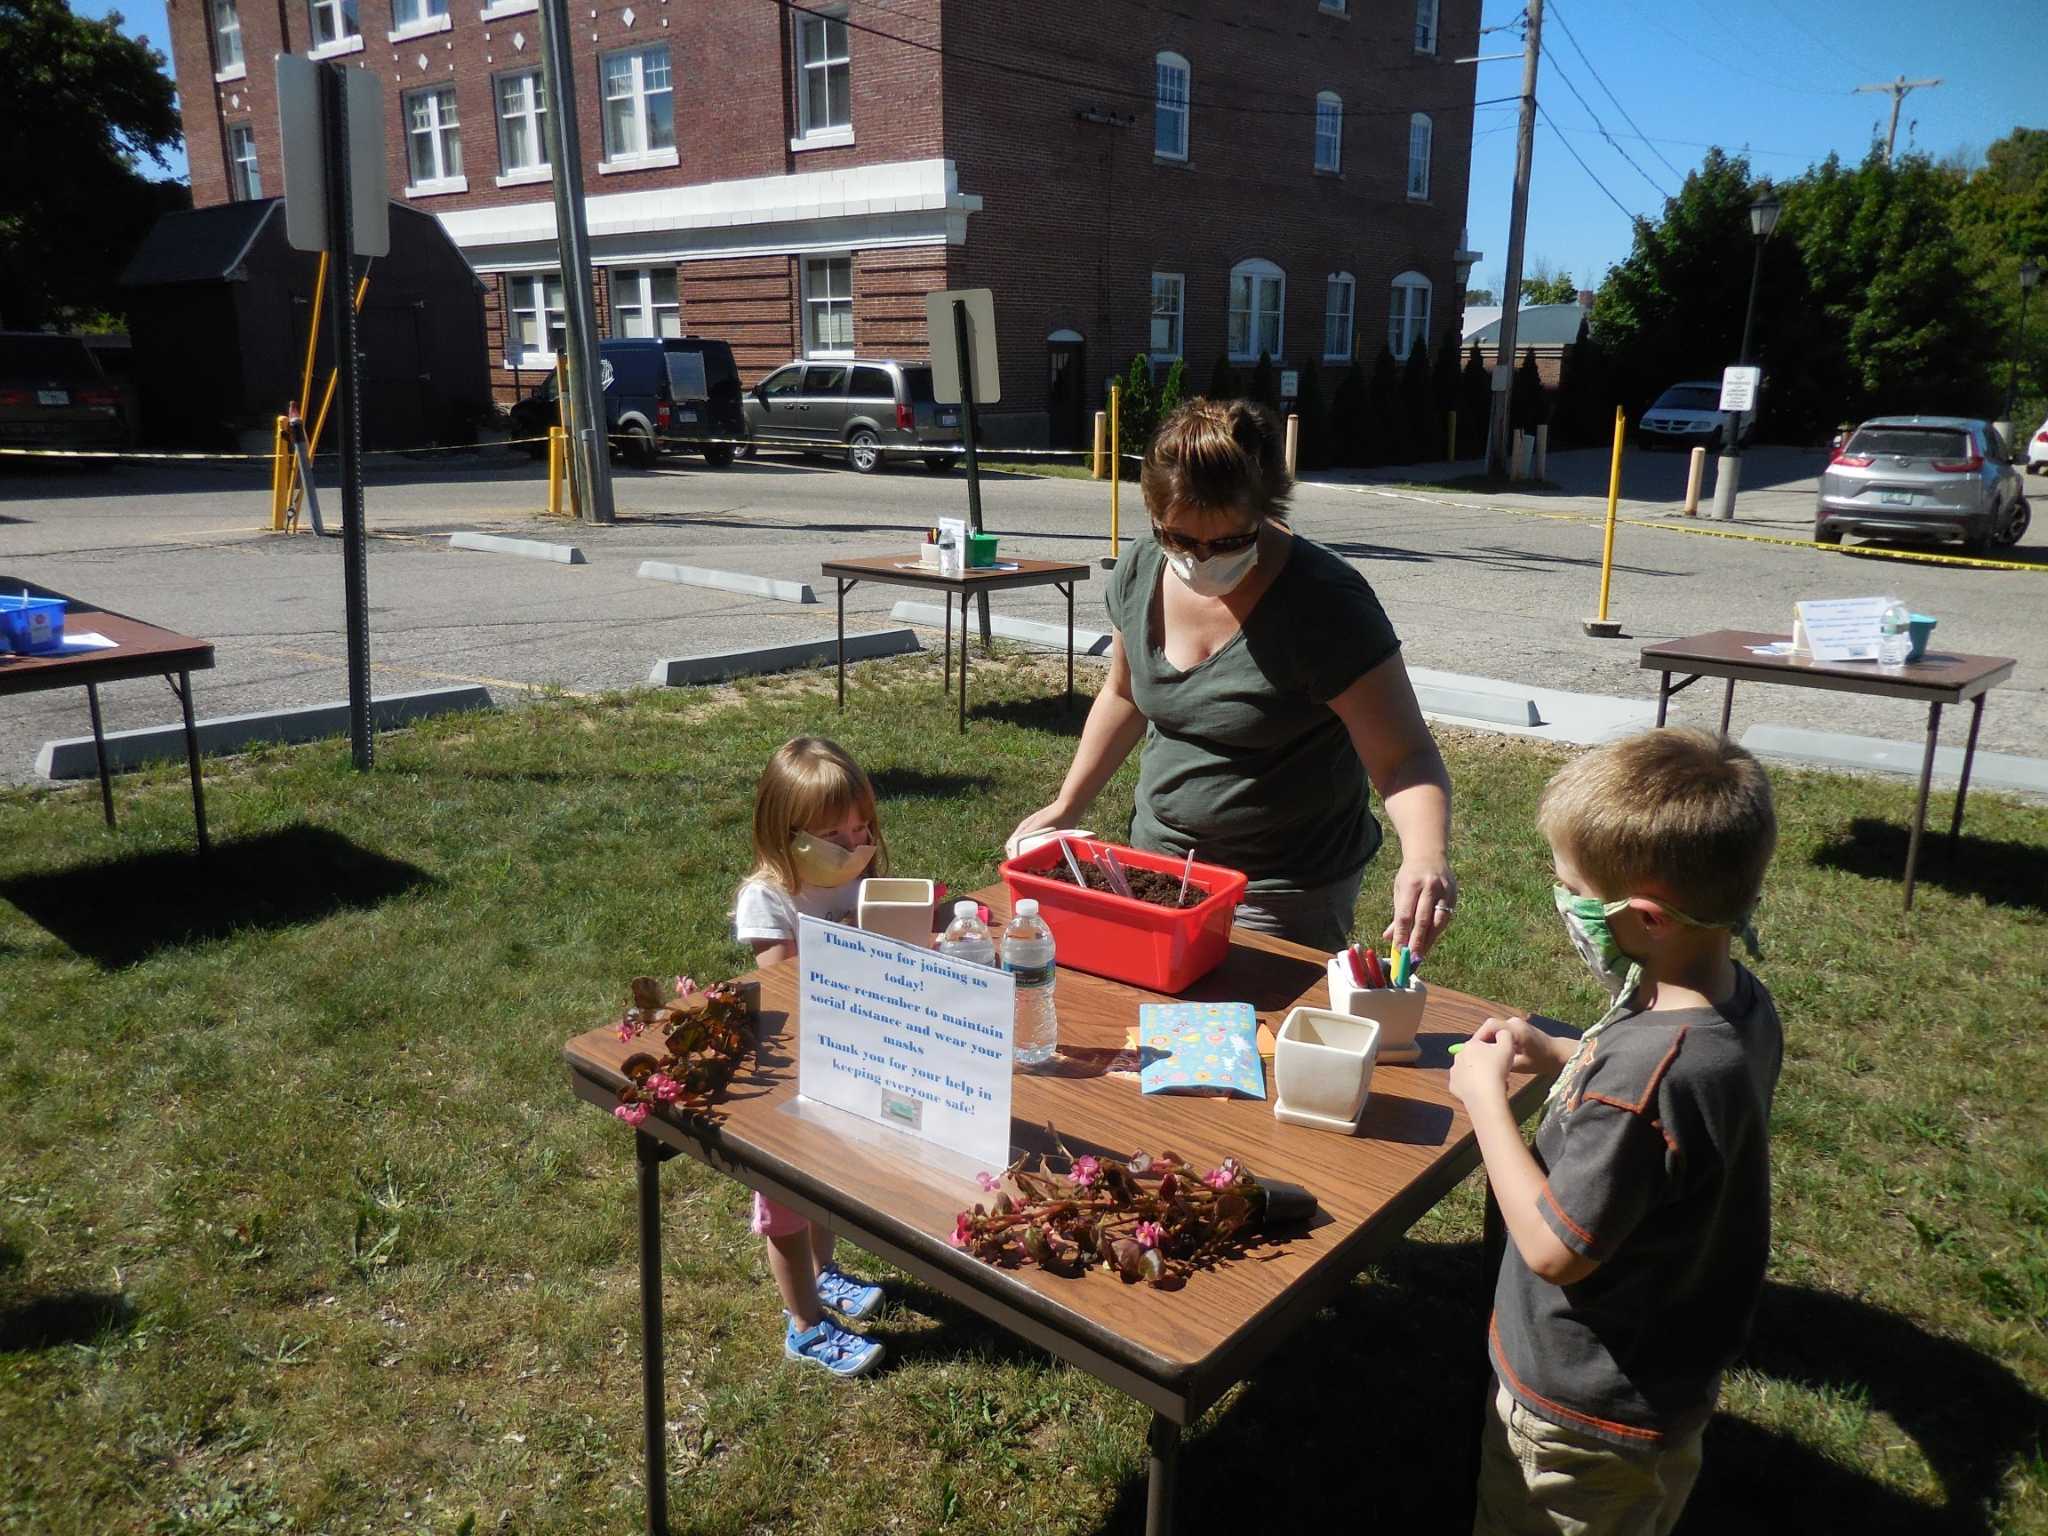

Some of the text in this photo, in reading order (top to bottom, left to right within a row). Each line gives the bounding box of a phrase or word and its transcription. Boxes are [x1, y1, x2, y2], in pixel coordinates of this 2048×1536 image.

[823, 931, 988, 988] Thank you for joining us
[884, 972, 924, 992] today!
[810, 971, 1004, 1039] Please remember to maintain
[810, 994, 1002, 1059] social distance and wear your
[818, 1033, 992, 1101] Thank you for your help in
[883, 1035, 924, 1055] masks
[832, 1058, 975, 1115] keeping everyone safe!
